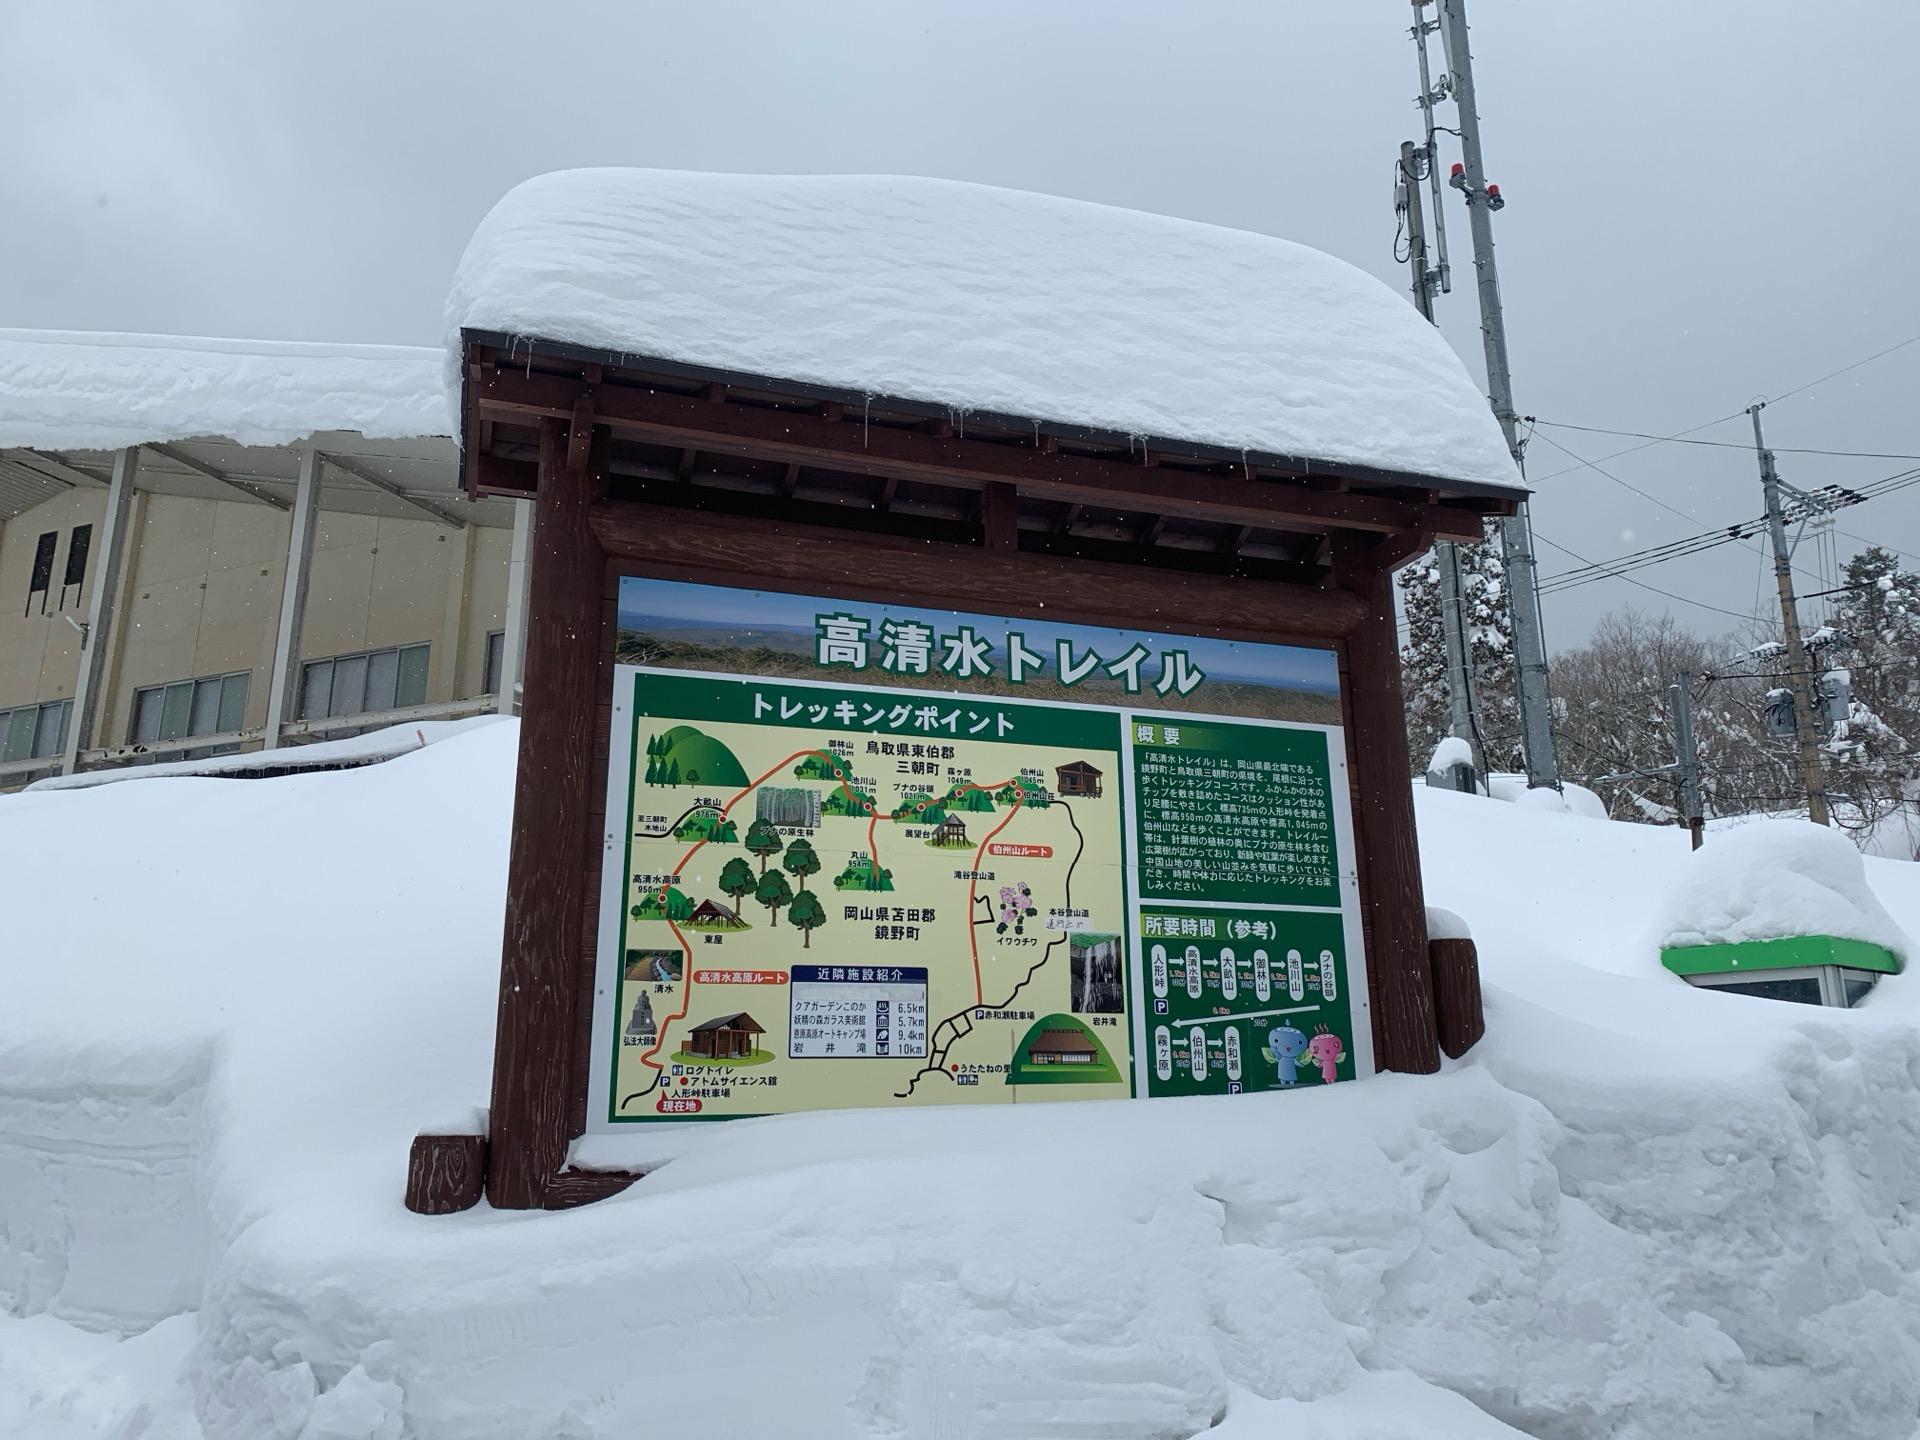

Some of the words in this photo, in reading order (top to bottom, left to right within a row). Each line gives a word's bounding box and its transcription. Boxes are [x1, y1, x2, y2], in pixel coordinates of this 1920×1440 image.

[816, 612, 1206, 698] 高清水トレイル
[754, 692, 1015, 737] トレッキングポイント
[1137, 725, 1180, 745] 概要
[828, 740, 854, 749] 御林山
[866, 740, 955, 760] 鳥取県東伯郡
[896, 761, 940, 776] 三朝町
[1021, 768, 1044, 777] 伯州山
[852, 777, 876, 786] 池川山
[1141, 775, 1324, 797] 歩くトレッキングコースです。ふかふかの木の
[893, 783, 934, 794] ブナの谷頭
[1142, 786, 1325, 808] チップを敷き詰めたコースはクッション性があ
[637, 815, 668, 823] 至三朝町
[645, 824, 667, 832] 木地山
[761, 827, 815, 837] ブナの原生林
[905, 829, 930, 838] 展望台
[851, 851, 868, 859] 丸山
[993, 845, 1048, 856] 伯州山ルート
[848, 860, 870, 868] 954m
[1145, 857, 1330, 876] 中国山地の美しい山並みを気軽に歩いていた
[633, 874, 681, 885] 高清水高原
[954, 870, 996, 881] 滝谷登山道
[638, 886, 662, 894] 950m
[1147, 880, 1204, 892] しみください。
[844, 905, 936, 923] 岡山県苫田郡
[1049, 908, 1089, 917] 本谷登山道
[875, 925, 920, 941] 鏡野町
[704, 935, 723, 945] 東屋
[997, 937, 1038, 946] イワウチワ
[817, 967, 903, 982] 近隣施設紹介
[1153, 955, 1165, 988] 人形峠
[1187, 950, 1200, 993] 高清水高原
[1255, 958, 1268, 992] 御林山
[1289, 958, 1301, 992] 池川山
[1322, 954, 1334, 997] ブナの谷頭
[700, 972, 785, 984] 高清水高原ルート
[654, 984, 674, 994] 清水
[795, 1001, 866, 1012] クアガーデンこのか
[898, 1003, 925, 1013] 6.5km
[794, 1015, 866, 1026] 妖精の森ガラス美術館
[985, 1011, 1035, 1020] 赤和瀬駐車場
[898, 1017, 925, 1027] 5.7km
[1092, 1017, 1117, 1026] 岩井滝
[793, 1029, 866, 1039] 恩原高原オートキャンプ場
[898, 1031, 925, 1041] 9.4km
[624, 1036, 656, 1047] 弘法大師像
[899, 1044, 922, 1054] 10km
[1192, 1035, 1205, 1071] 伯州山
[1227, 1036, 1240, 1071] 赤和瀬
[686, 1066, 734, 1076] ログトイレ
[961, 1064, 1011, 1073] うたたねの里
[691, 1076, 778, 1087] アトムサイエンス館
[672, 1088, 731, 1098] 人形峠駐車場
[662, 1101, 697, 1112] 現在地
